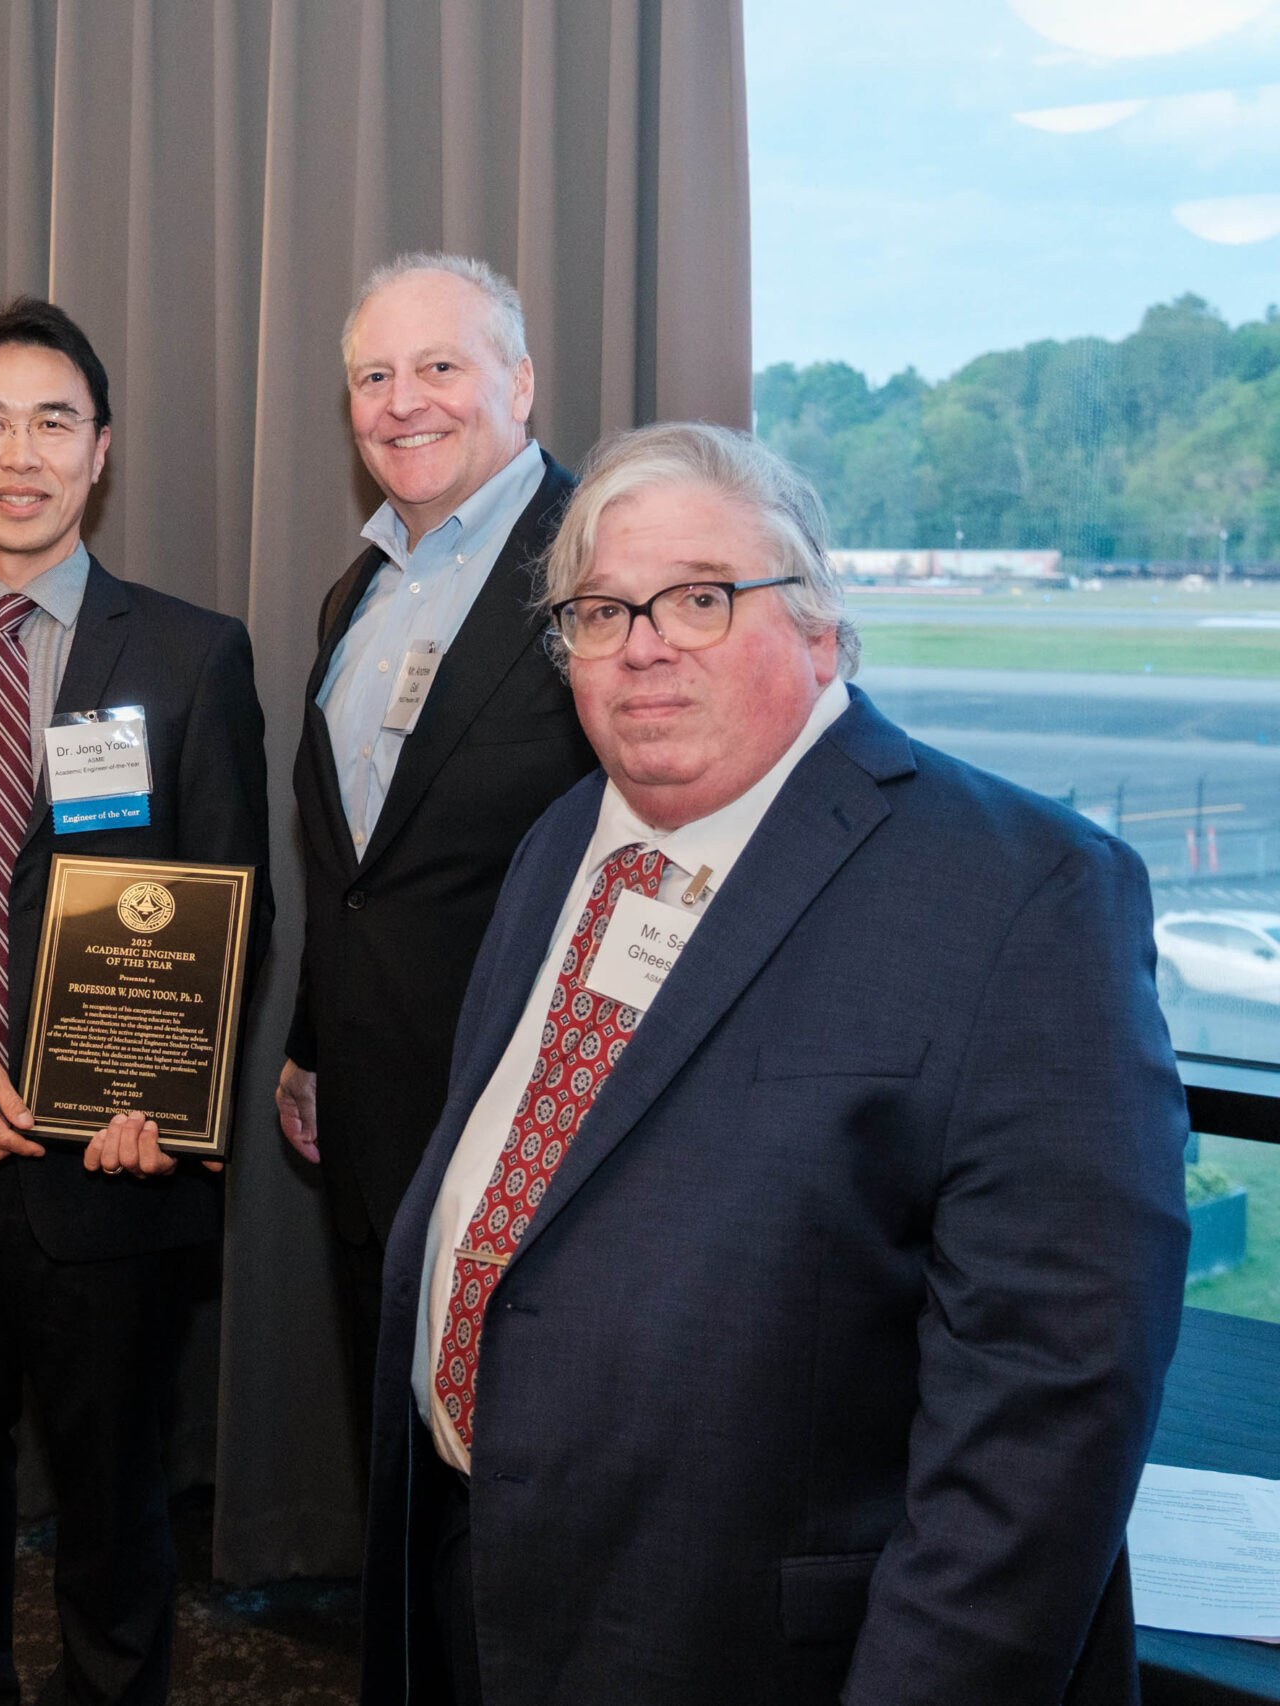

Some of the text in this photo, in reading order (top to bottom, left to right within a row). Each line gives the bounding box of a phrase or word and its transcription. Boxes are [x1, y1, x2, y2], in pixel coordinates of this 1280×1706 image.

[56, 746, 73, 757] Dr.
[76, 744, 103, 755] Jong
[62, 809, 140, 824] Engineer of the Year
[640, 924, 662, 943] Mr.
[131, 938, 153, 947] 2025
[85, 945, 196, 962] ACADEMIC ENGINEER
[106, 957, 173, 970] OF THE YEAR
[119, 974, 148, 983] Presented
[68, 983, 204, 1003] PROFESSOR W. JONG YOON, Ph. D.
[111, 1080, 136, 1088] Awarded
[111, 1089, 127, 1098] April
[54, 1102, 78, 1110] PUGET
[78, 1104, 104, 1112] SOUND
[155, 1111, 189, 1121] COUNCIL
